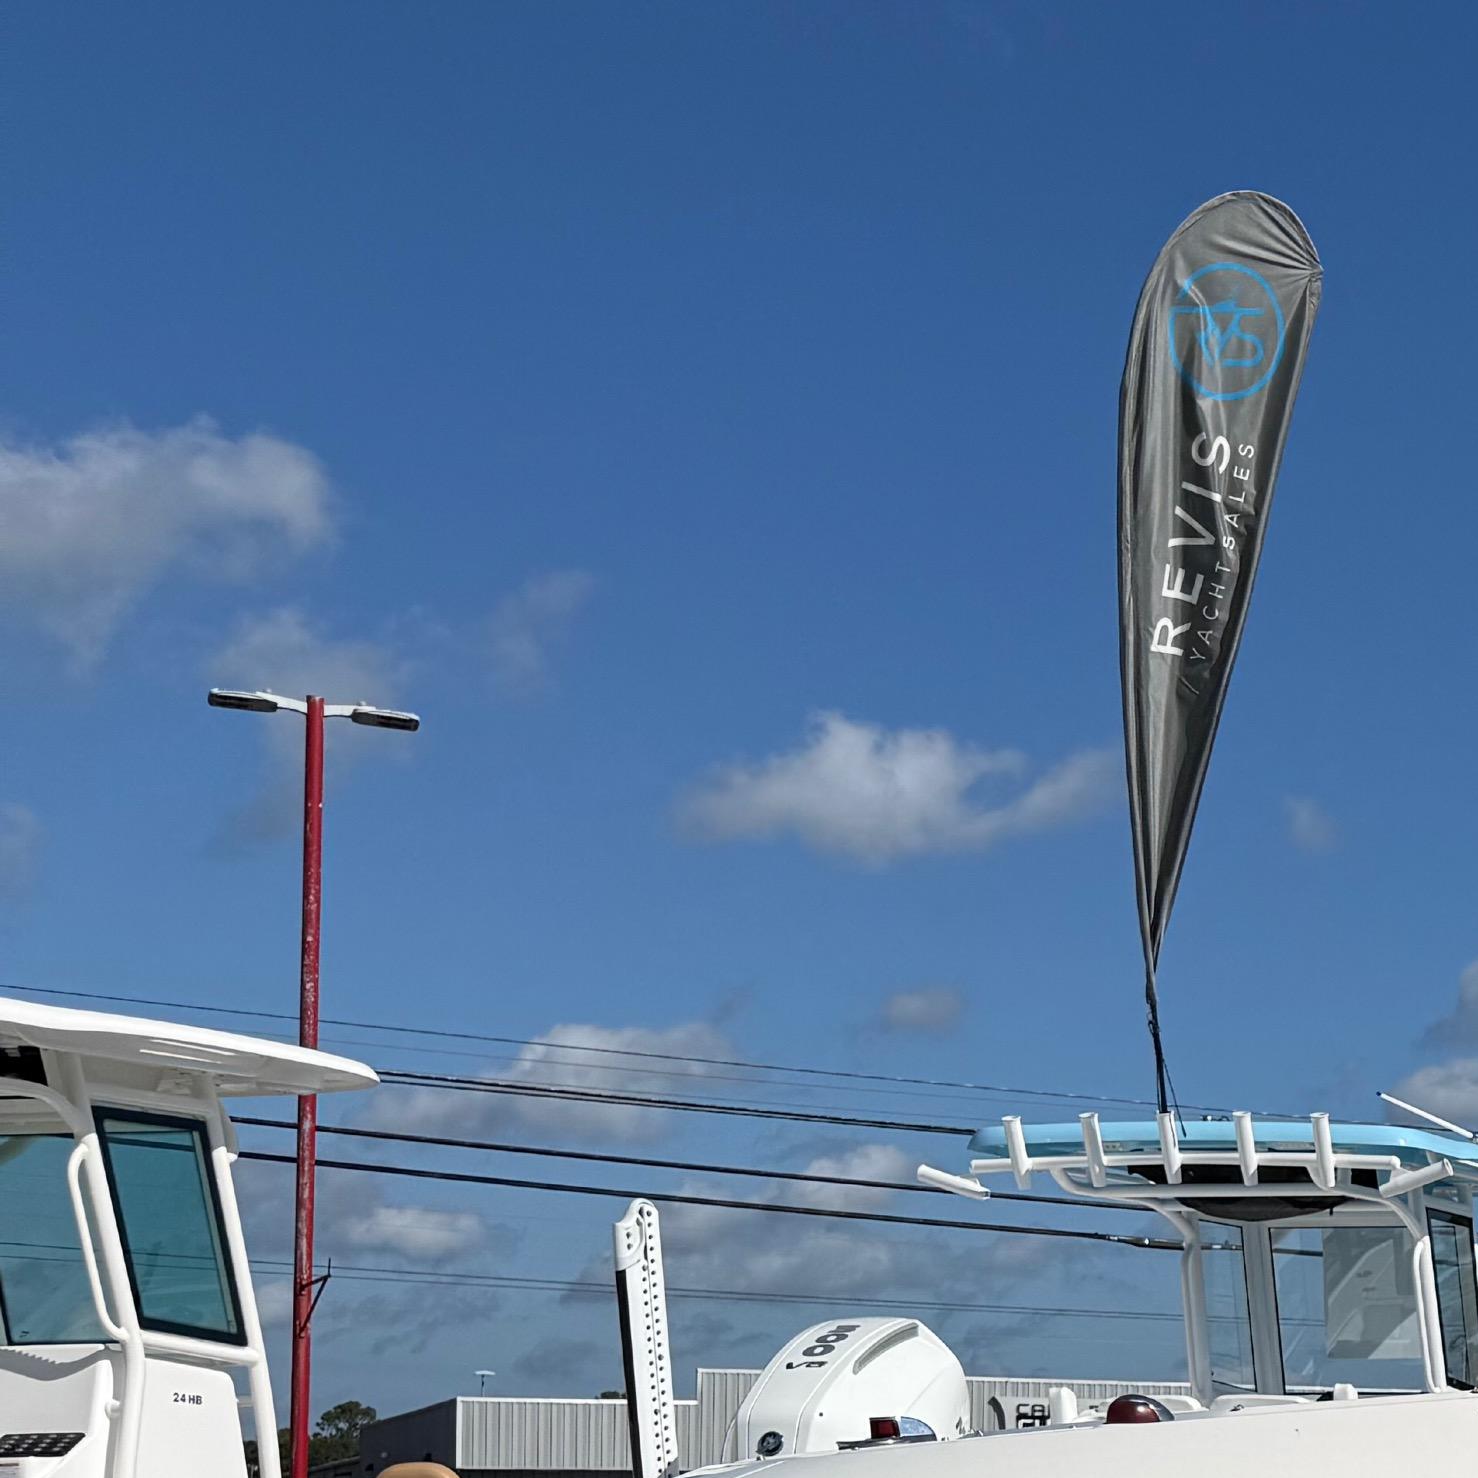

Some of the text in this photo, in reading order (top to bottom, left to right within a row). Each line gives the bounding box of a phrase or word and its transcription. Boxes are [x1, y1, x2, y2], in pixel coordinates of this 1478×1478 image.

[1151, 431, 1231, 656] REVIS
[1190, 444, 1256, 660] YACHT SALES
[173, 1392, 203, 1405] 24 HB
